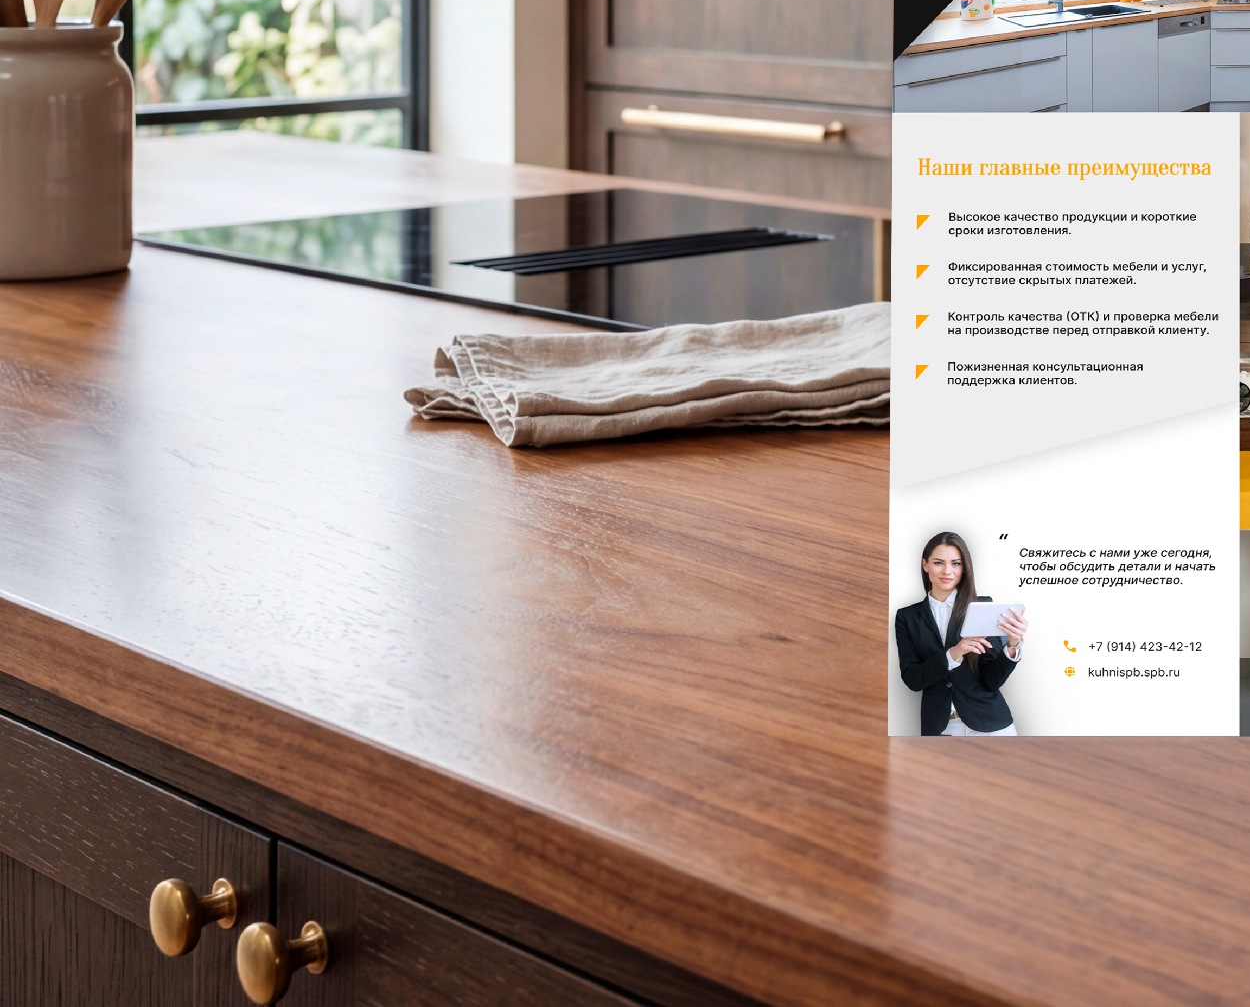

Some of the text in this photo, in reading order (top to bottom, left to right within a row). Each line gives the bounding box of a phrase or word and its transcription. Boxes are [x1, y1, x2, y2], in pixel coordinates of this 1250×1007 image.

[917, 157, 1212, 181] Наши главные преимущества
[948, 212, 1197, 224] Высокое качество продукции и короткие
[948, 227, 1072, 238] сроки изготовления.
[947, 261, 1207, 274] Фиксированная стоимость мебели и услуг,
[947, 275, 1137, 287] отсутствие скрытых платежей.
[947, 310, 1219, 324] Контроль качества (ОТК) и проверка мебели
[947, 325, 1210, 337] на производстве перед отправкой клиенту.
[947, 361, 1144, 374] Пожизненная консультационная
[947, 377, 1078, 387] поддержка клиентов.
[1019, 547, 1212, 560] Свяжитесь с нами уже сегодня,
[1019, 561, 1216, 574] чтобы обсудить детали и начать
[1018, 577, 1183, 588] успешное сотрудничество.
[1088, 640, 1202, 653] +7 (914) 423-42-12
[1088, 666, 1180, 680] kuhnispb.spb.ru
